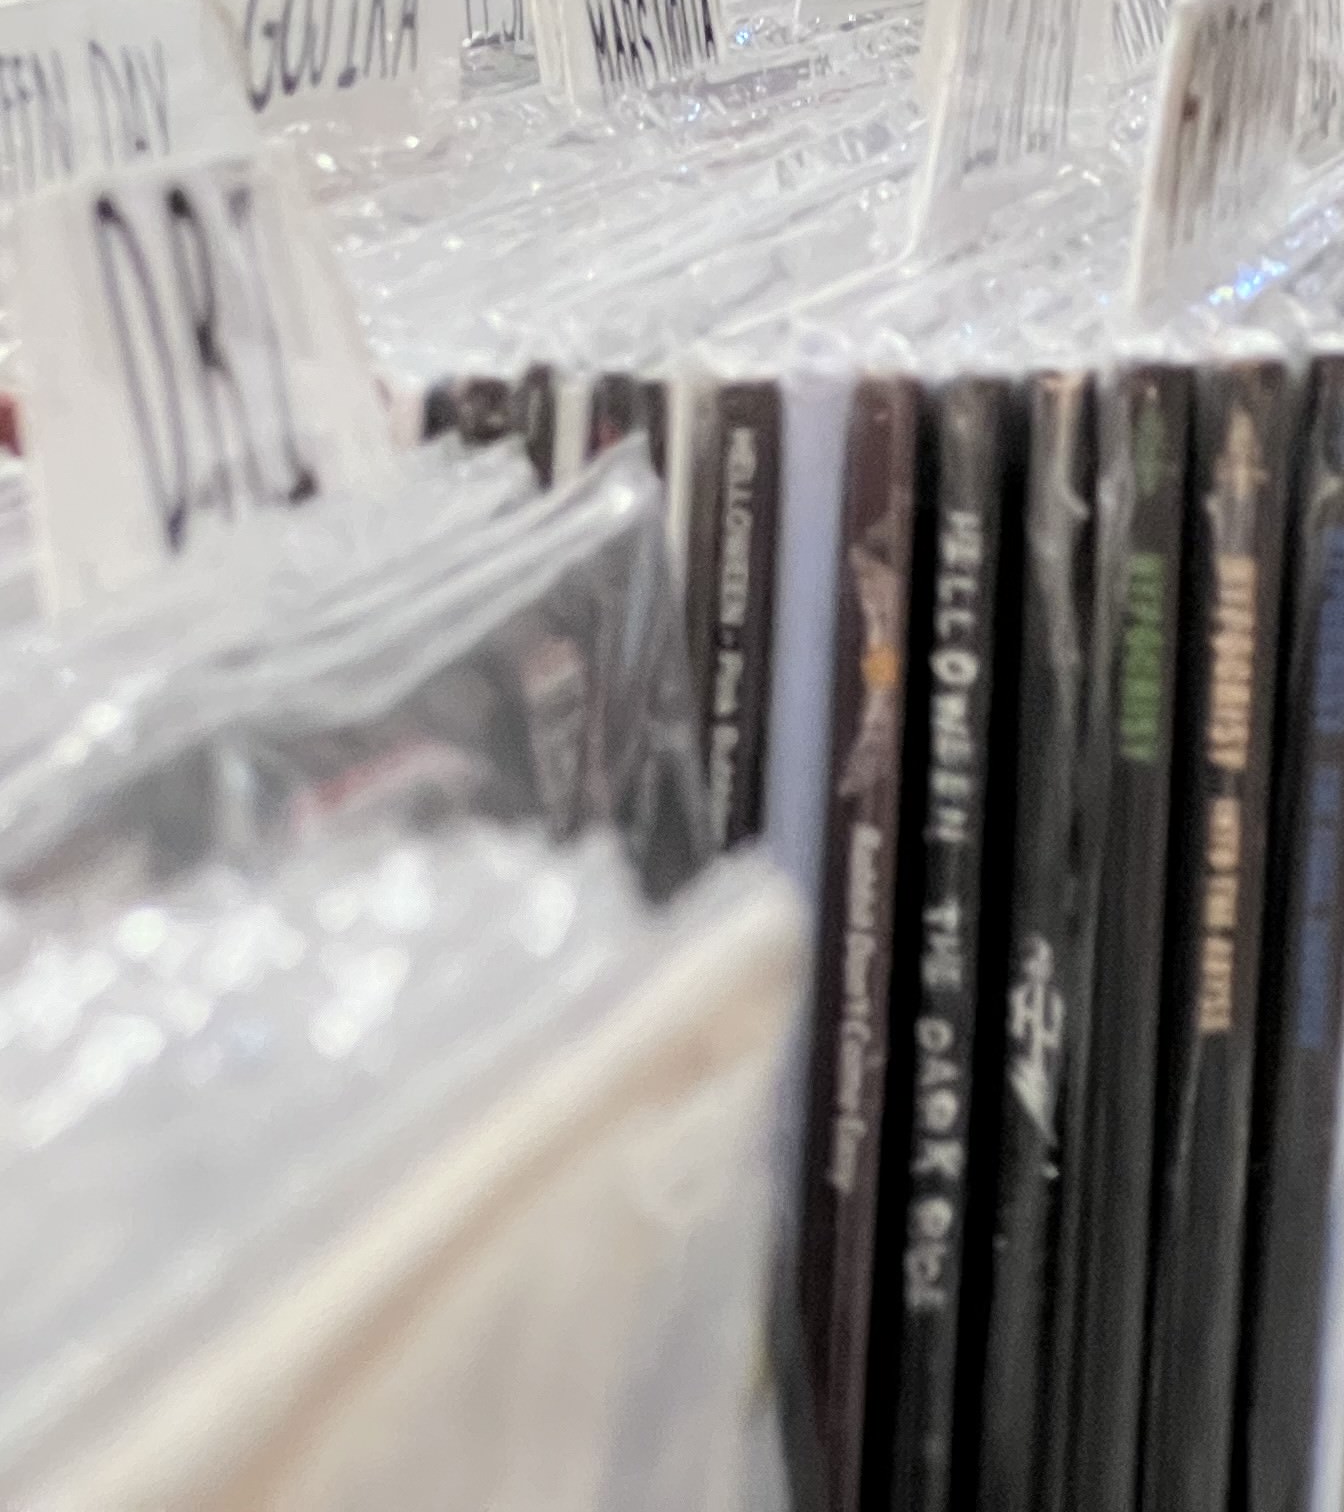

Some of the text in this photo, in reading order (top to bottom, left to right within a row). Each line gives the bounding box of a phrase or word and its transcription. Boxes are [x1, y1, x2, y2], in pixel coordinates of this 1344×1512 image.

[921, 509, 985, 844] HELLOWEEN
[917, 900, 963, 993] THE
[906, 1015, 961, 1180] DARK
